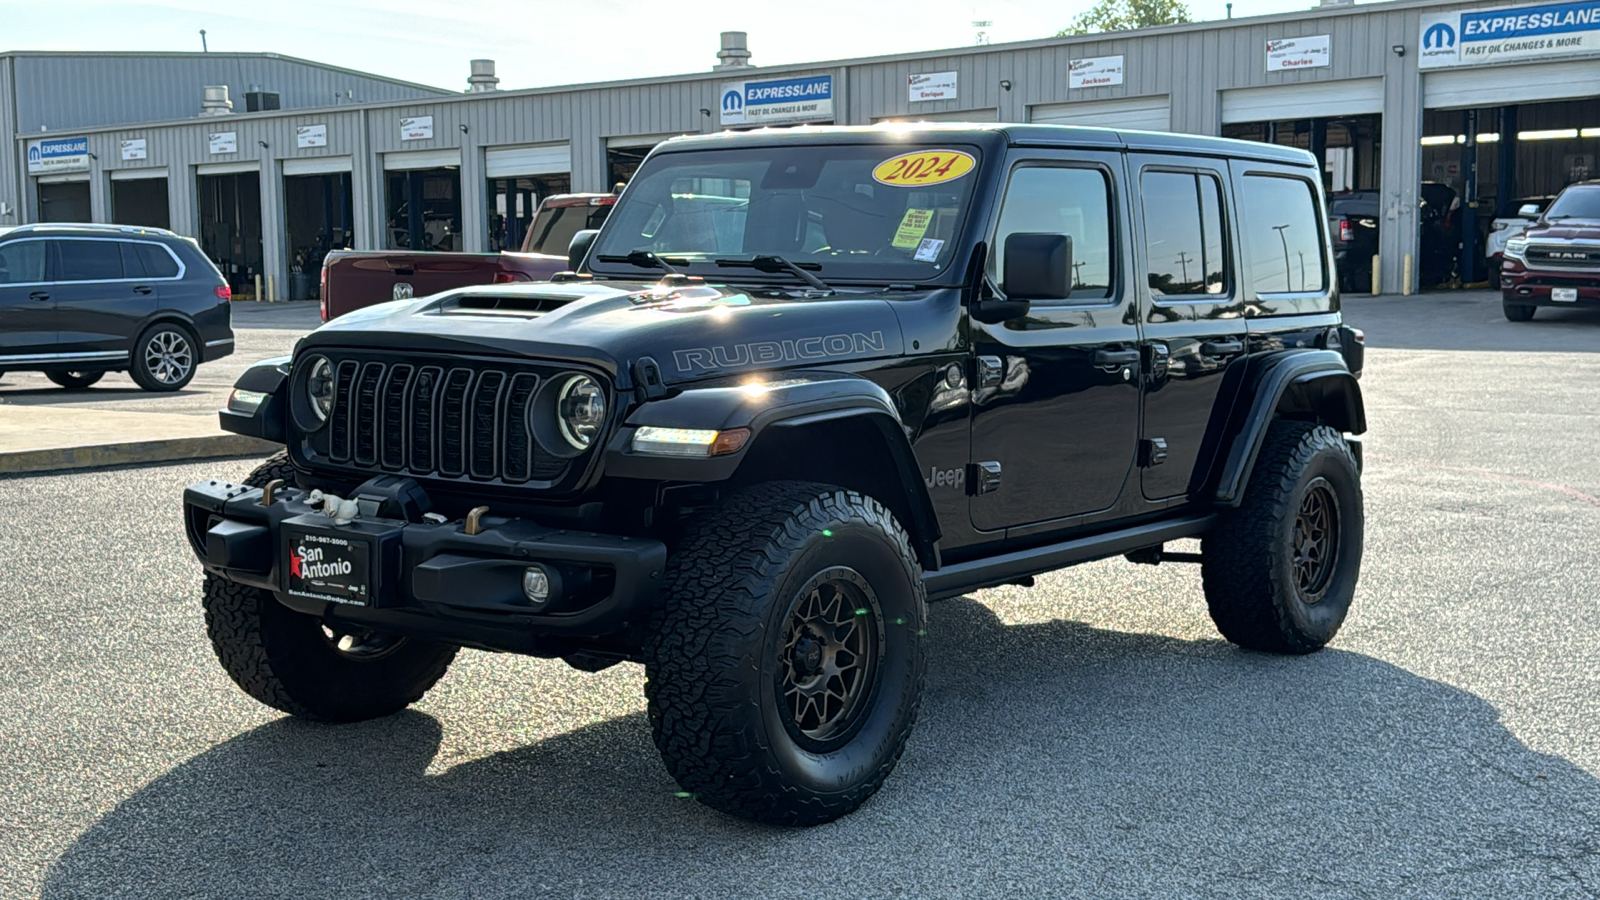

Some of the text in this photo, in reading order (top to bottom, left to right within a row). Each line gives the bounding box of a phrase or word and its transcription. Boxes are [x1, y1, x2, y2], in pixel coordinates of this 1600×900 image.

[1464, 8, 1600, 35] EXPRESSLANE
[1465, 37, 1582, 55] FAST OIL CHANGES & MORE
[1282, 59, 1313, 67] Charles
[1081, 77, 1111, 85] Jackson
[747, 82, 830, 100] EXPRESSLANE
[771, 105, 795, 114] CHANGES
[42, 142, 87, 154] EXPRESSLANE
[883, 155, 960, 180] 2024
[672, 330, 885, 371] RUBICON
[924, 466, 965, 489] Jeep
[297, 546, 323, 562] San
[301, 557, 352, 579] Antonio
[288, 589, 365, 606] SanAntonioDodge.com
